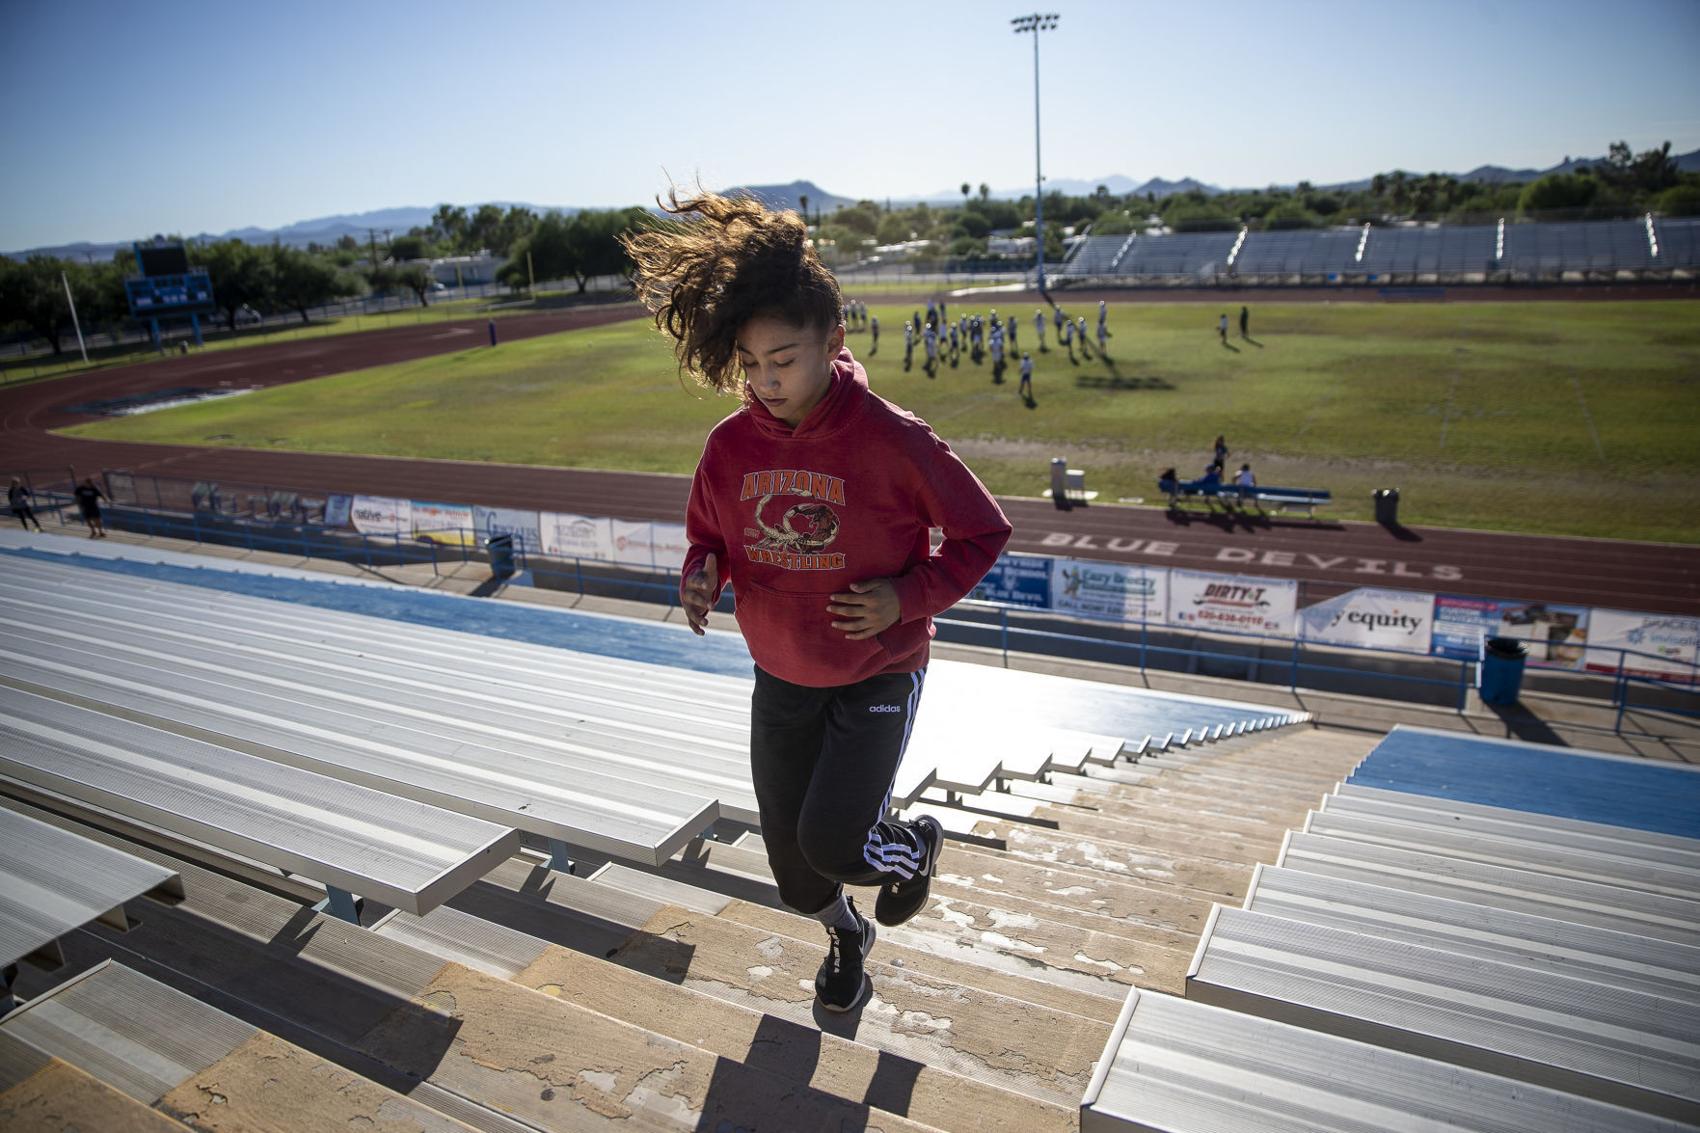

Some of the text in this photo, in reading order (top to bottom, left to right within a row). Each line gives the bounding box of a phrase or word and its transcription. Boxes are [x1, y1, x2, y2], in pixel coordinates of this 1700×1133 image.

[740, 469, 846, 506] ARIZONA
[743, 544, 846, 571] WRESTLING
[1040, 532, 1180, 556] BLUE
[1215, 546, 1464, 581] DEVILS
[1204, 583, 1251, 600] DIRTY
[1348, 608, 1423, 636] equity
[869, 704, 901, 713] adidas
